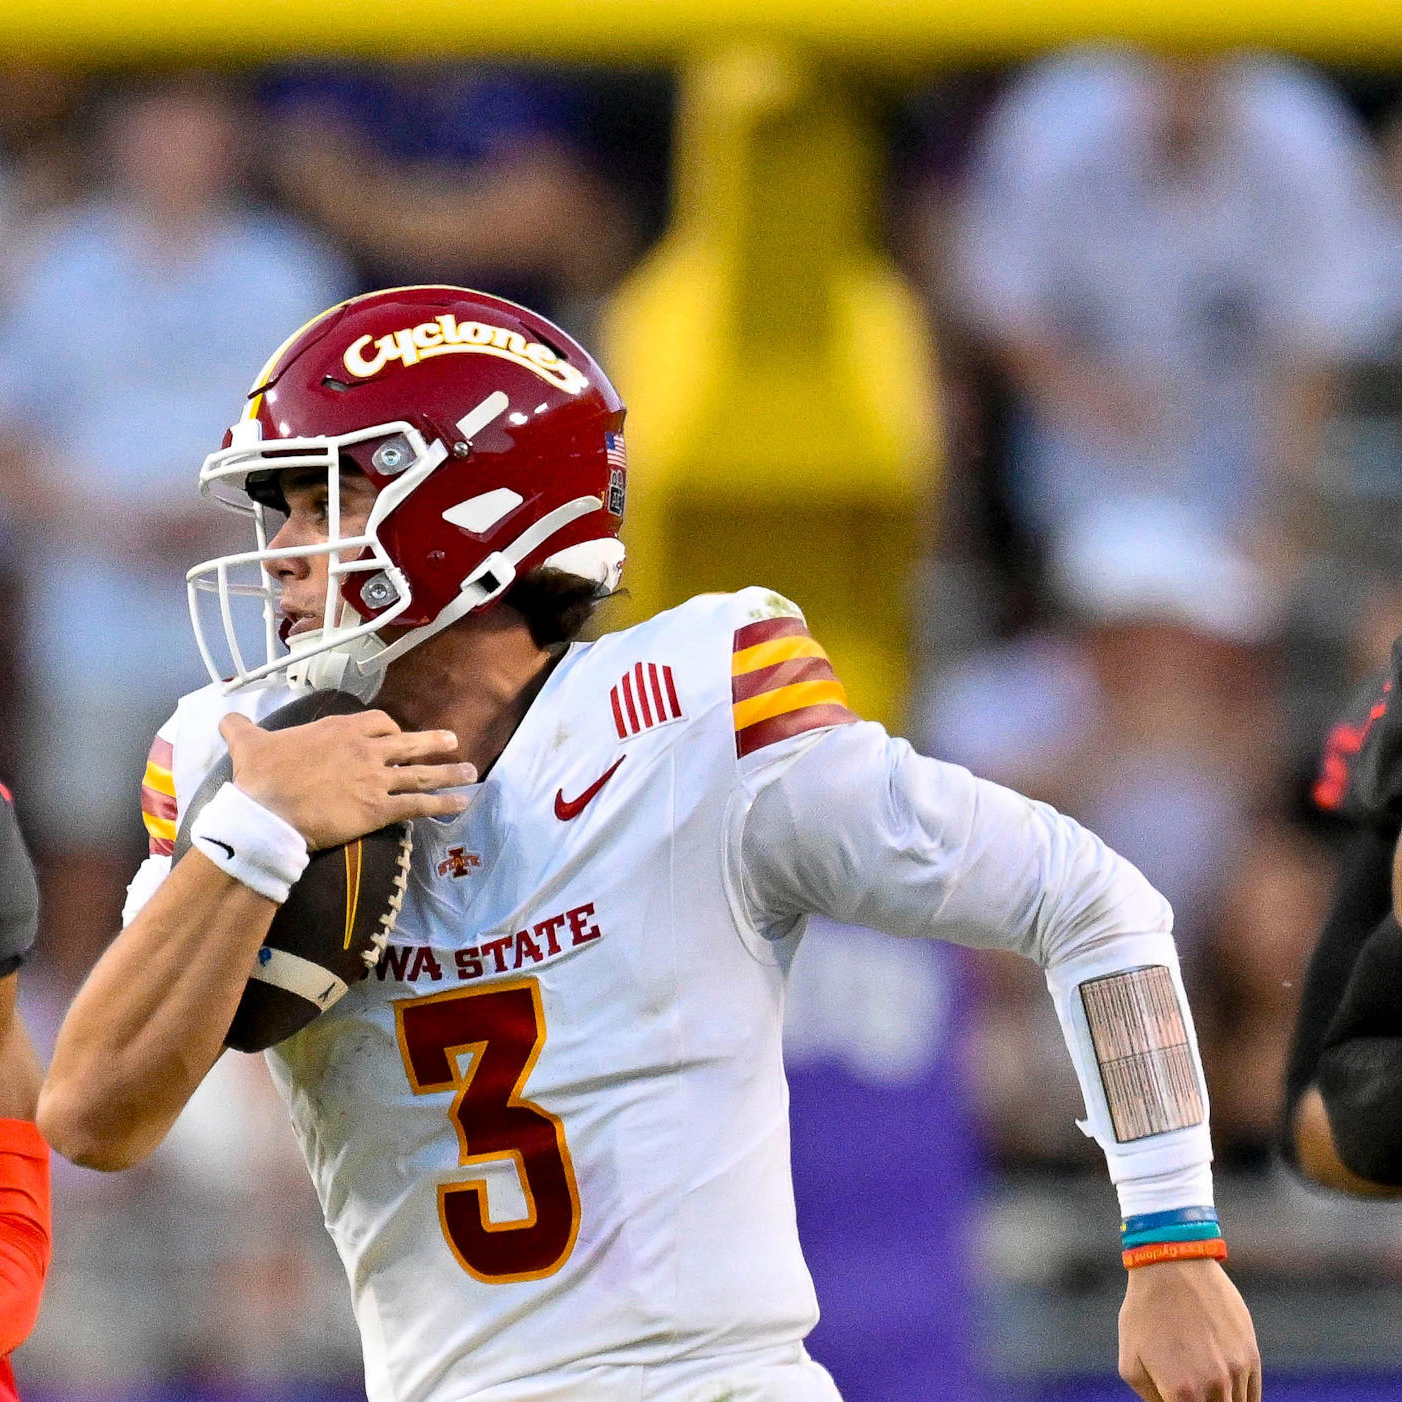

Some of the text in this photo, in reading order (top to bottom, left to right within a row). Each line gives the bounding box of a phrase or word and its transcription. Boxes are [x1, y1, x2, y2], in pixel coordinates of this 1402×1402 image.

[343, 313, 590, 395] Cyclones
[359, 902, 601, 982] WA STATE
[393, 976, 583, 1286] 3
